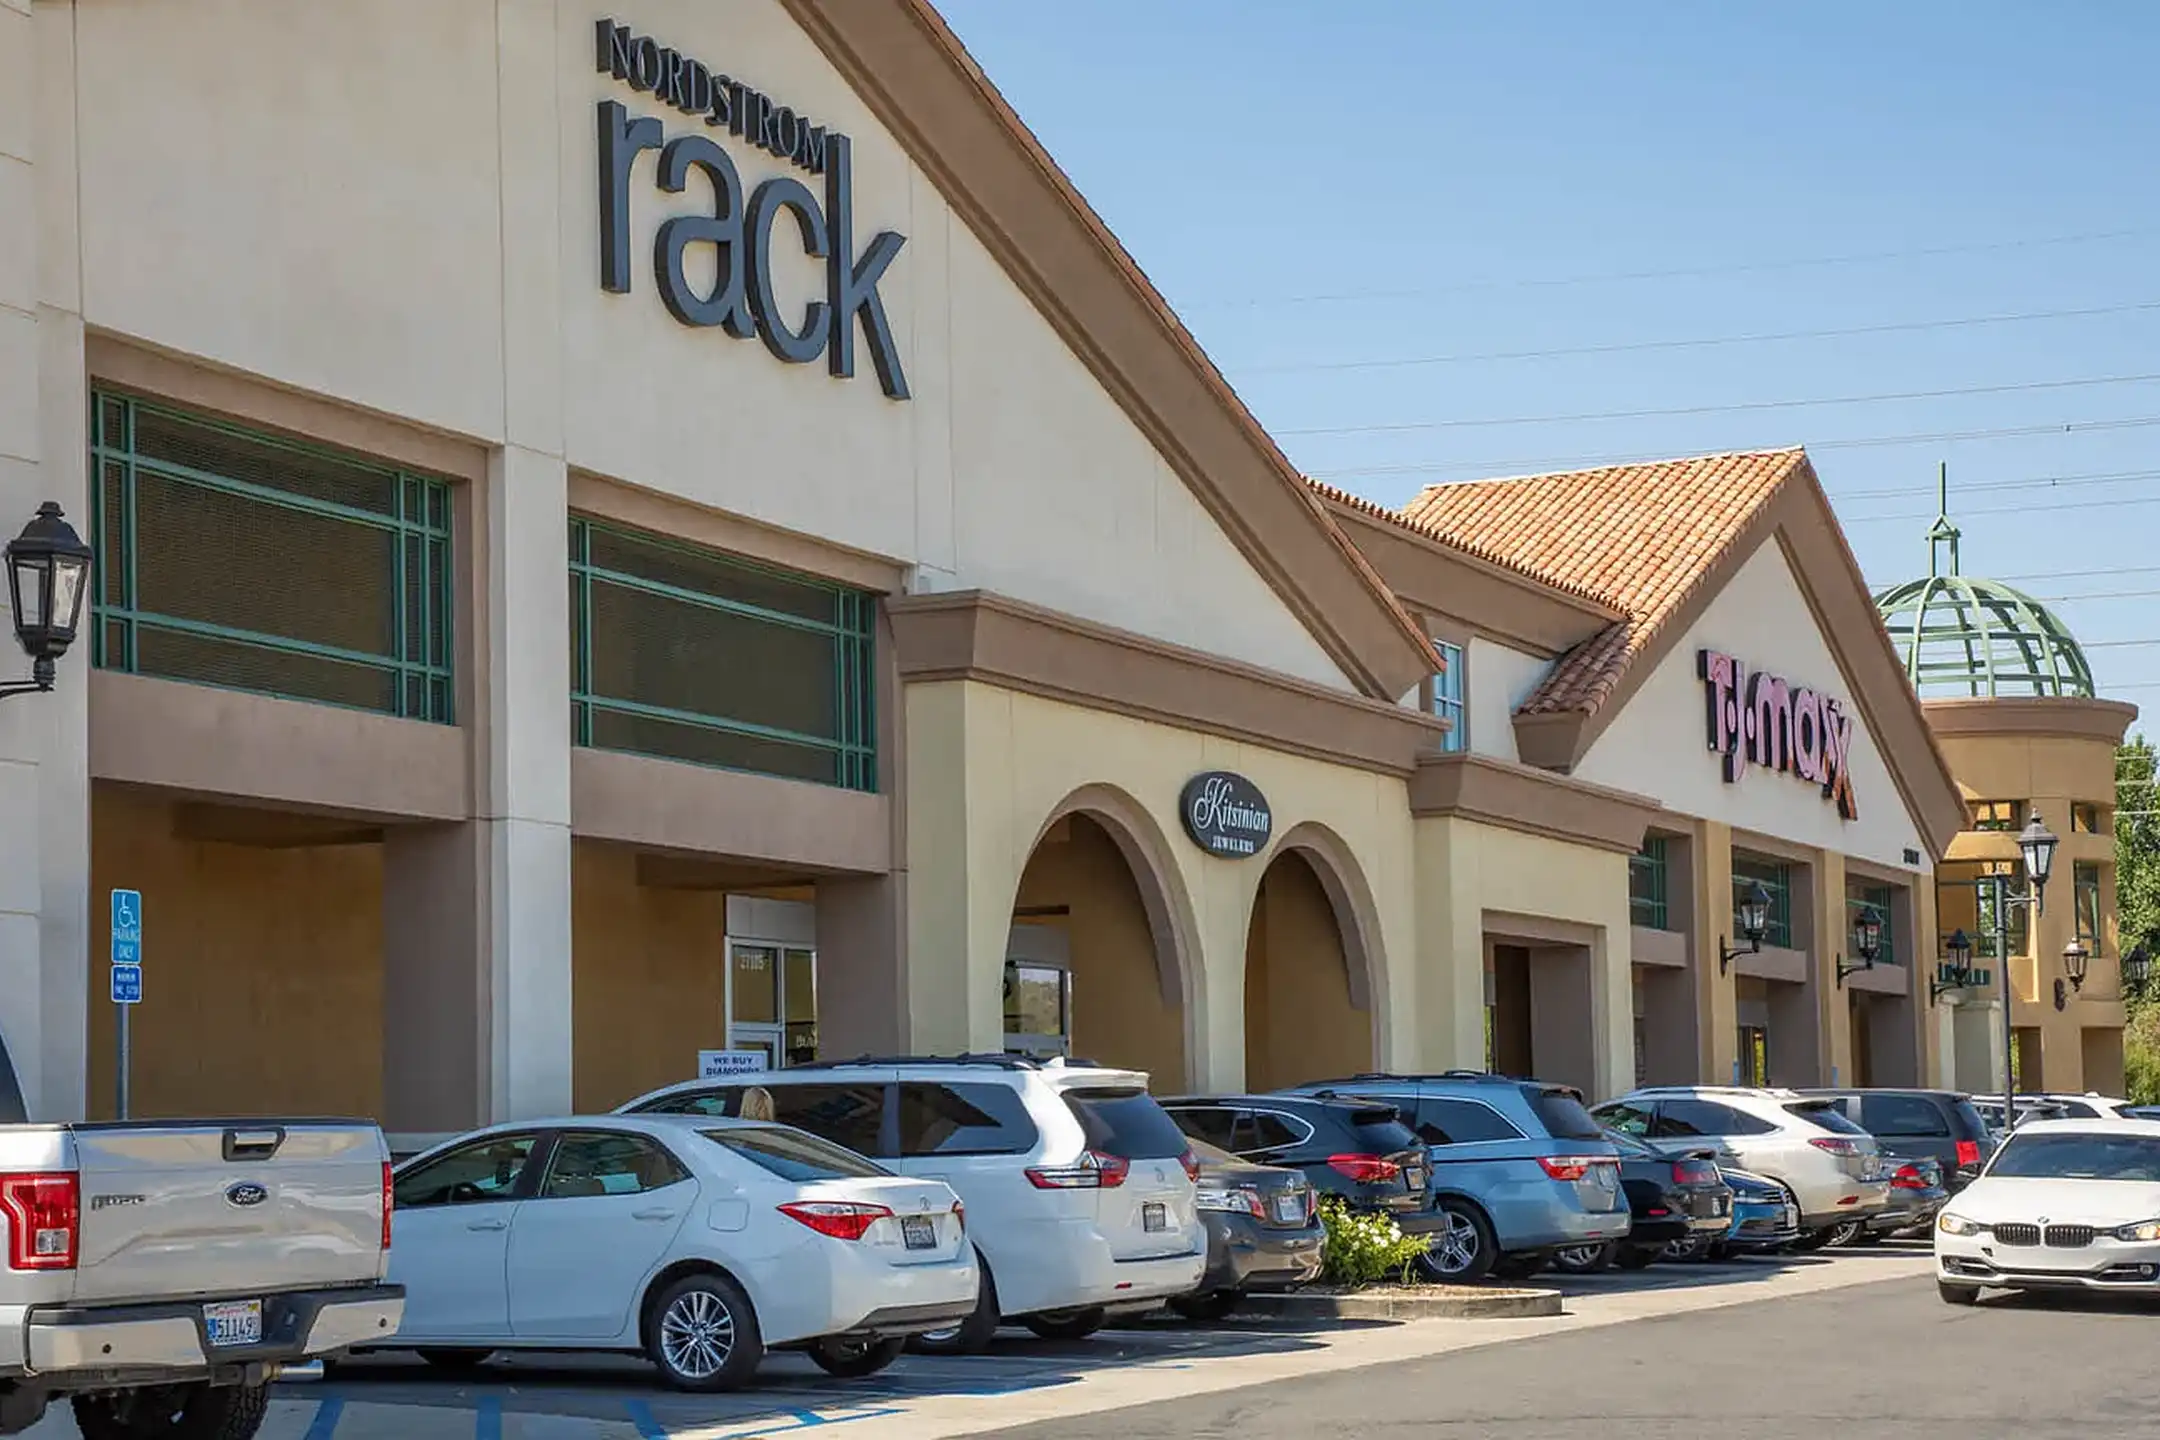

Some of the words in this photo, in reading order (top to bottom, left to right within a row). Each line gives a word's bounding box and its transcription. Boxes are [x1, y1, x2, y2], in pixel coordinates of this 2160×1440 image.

[596, 18, 827, 174] NORDSTROM
[597, 100, 911, 400] rack
[732, 1056, 752, 1065] BUY
